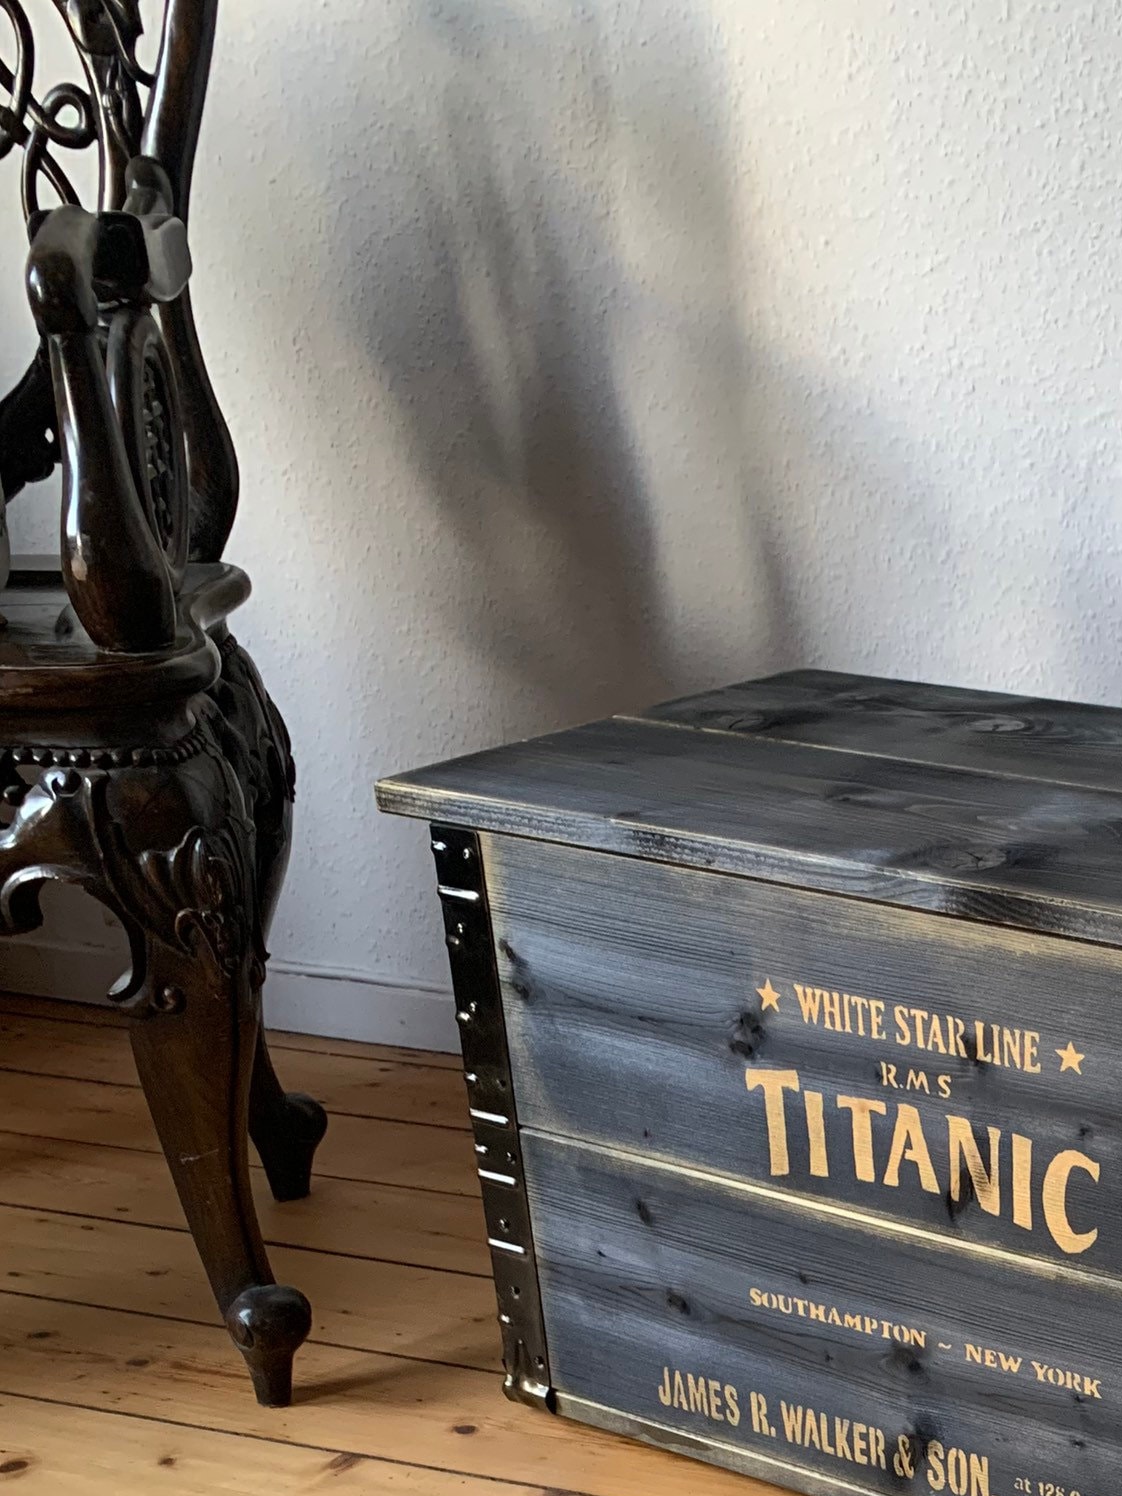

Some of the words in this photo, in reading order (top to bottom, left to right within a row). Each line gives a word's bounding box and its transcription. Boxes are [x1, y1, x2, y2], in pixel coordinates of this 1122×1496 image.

[793, 983, 887, 1040] WHITE
[894, 1004, 968, 1059] STAR
[974, 1020, 1042, 1074] LINE
[745, 1068, 1100, 1254] TITANIC
[749, 1286, 928, 1349] SOUTHAMPTON
[964, 1342, 1023, 1374] NEW
[1030, 1360, 1102, 1399] YORK
[658, 1366, 740, 1427] JAMES
[749, 1391, 776, 1438] R.
[780, 1400, 887, 1471] WALKER
[893, 1434, 915, 1480] &
[1013, 1477, 1032, 1494] at
